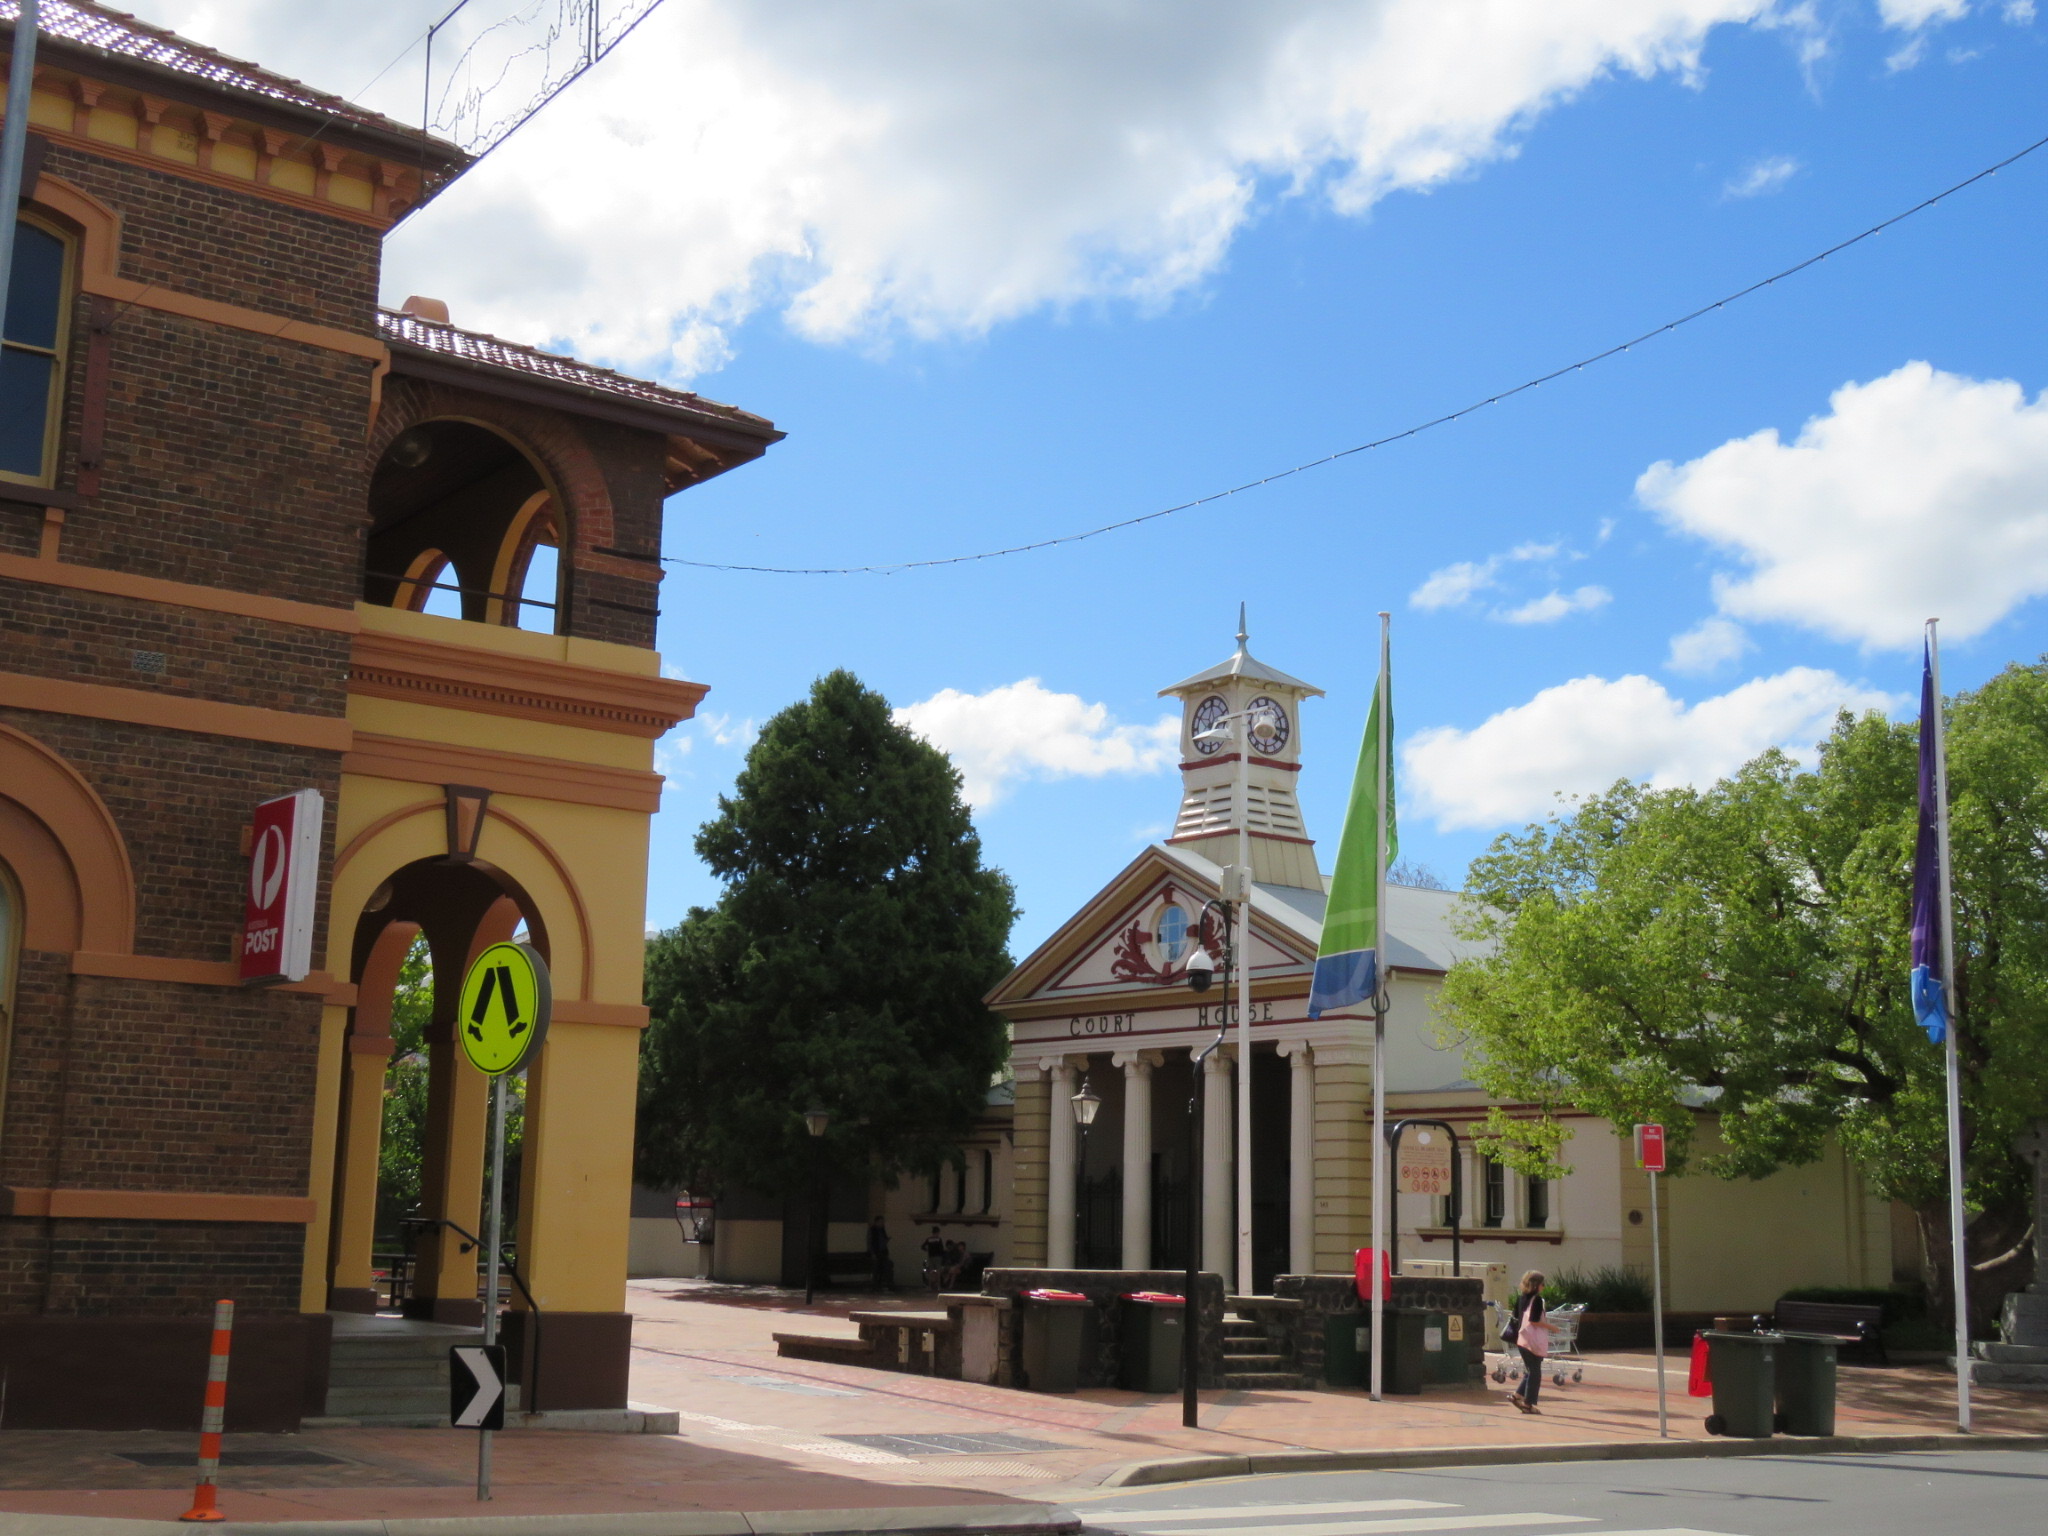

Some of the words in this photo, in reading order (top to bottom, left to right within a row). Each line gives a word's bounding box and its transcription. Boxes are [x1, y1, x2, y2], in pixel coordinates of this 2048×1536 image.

[245, 928, 278, 955] POST
[1070, 1013, 1135, 1037] COURT
[1198, 1002, 1273, 1026] HOUSE
